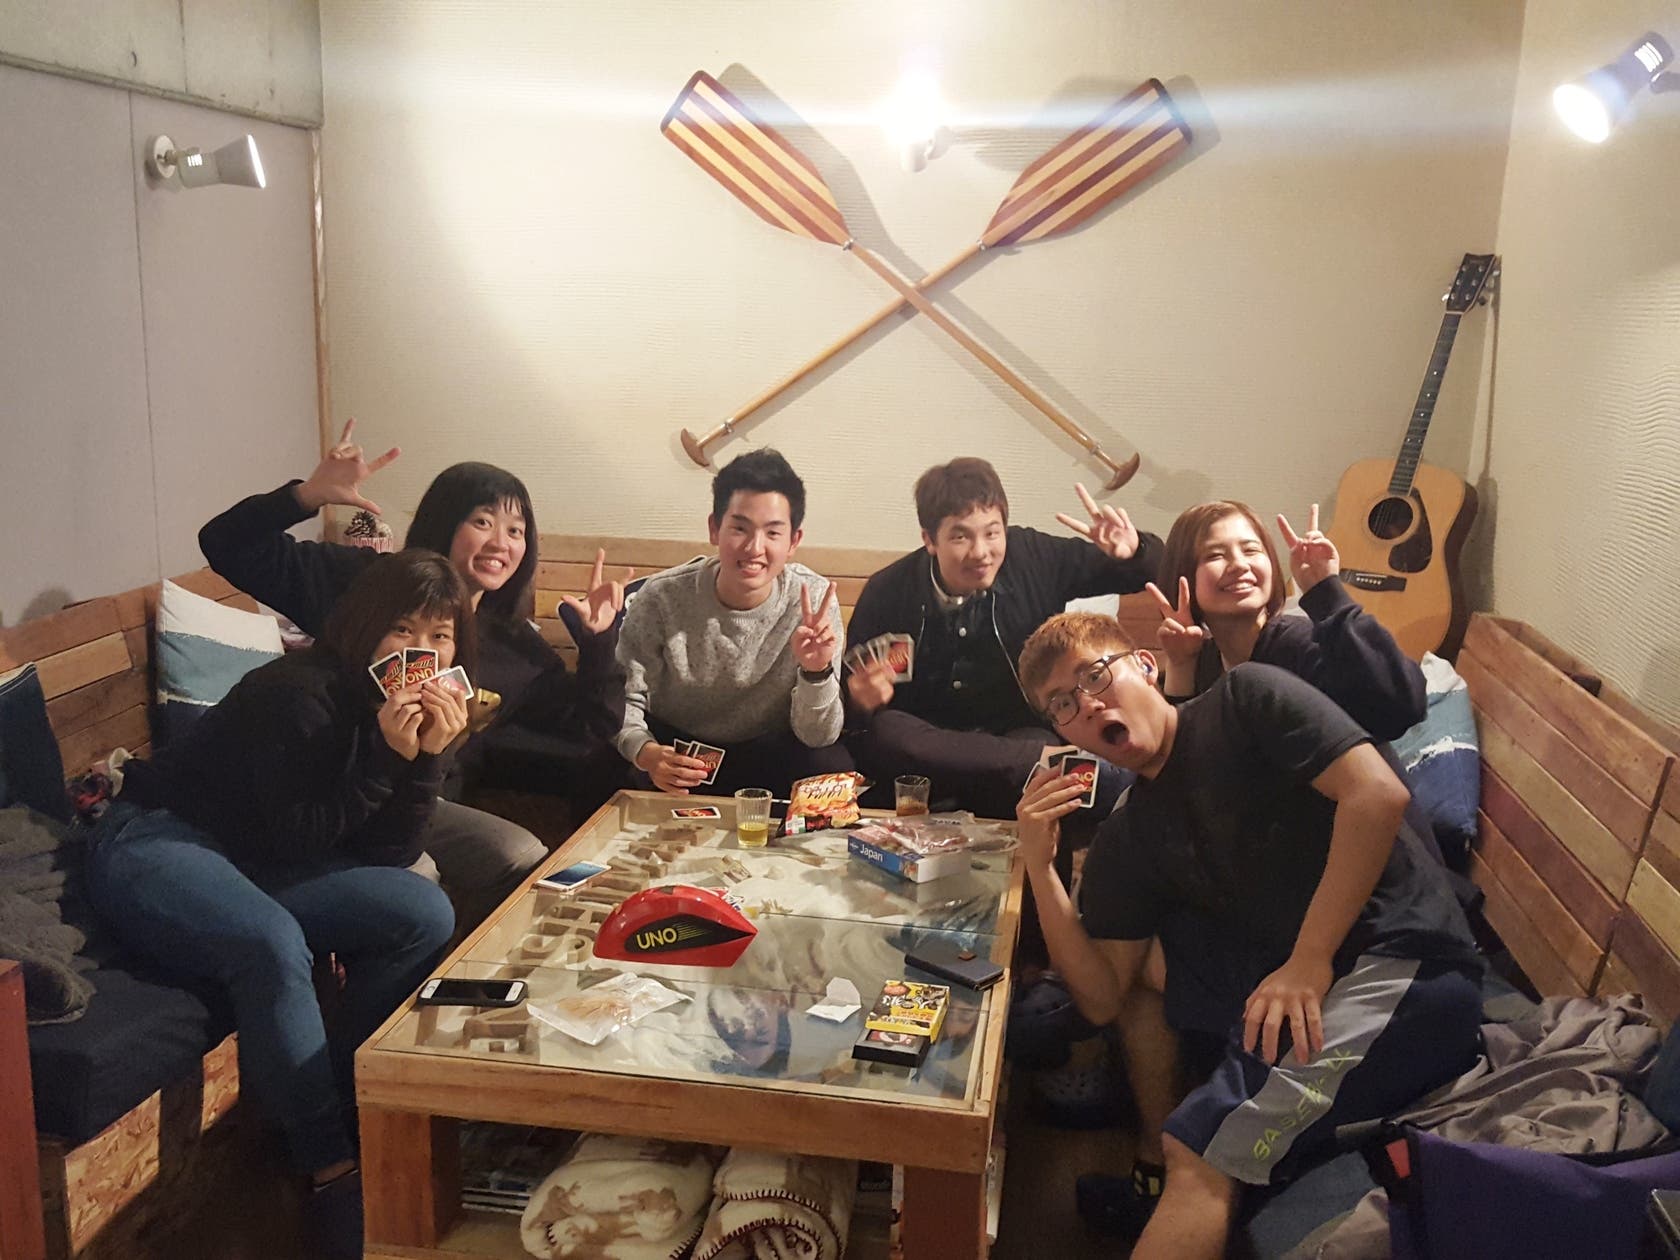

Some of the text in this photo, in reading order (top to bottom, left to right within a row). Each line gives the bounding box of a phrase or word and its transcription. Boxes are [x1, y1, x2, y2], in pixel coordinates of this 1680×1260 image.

[406, 668, 434, 684] UNO
[860, 844, 884, 863] Japan
[636, 926, 678, 950] UNO
